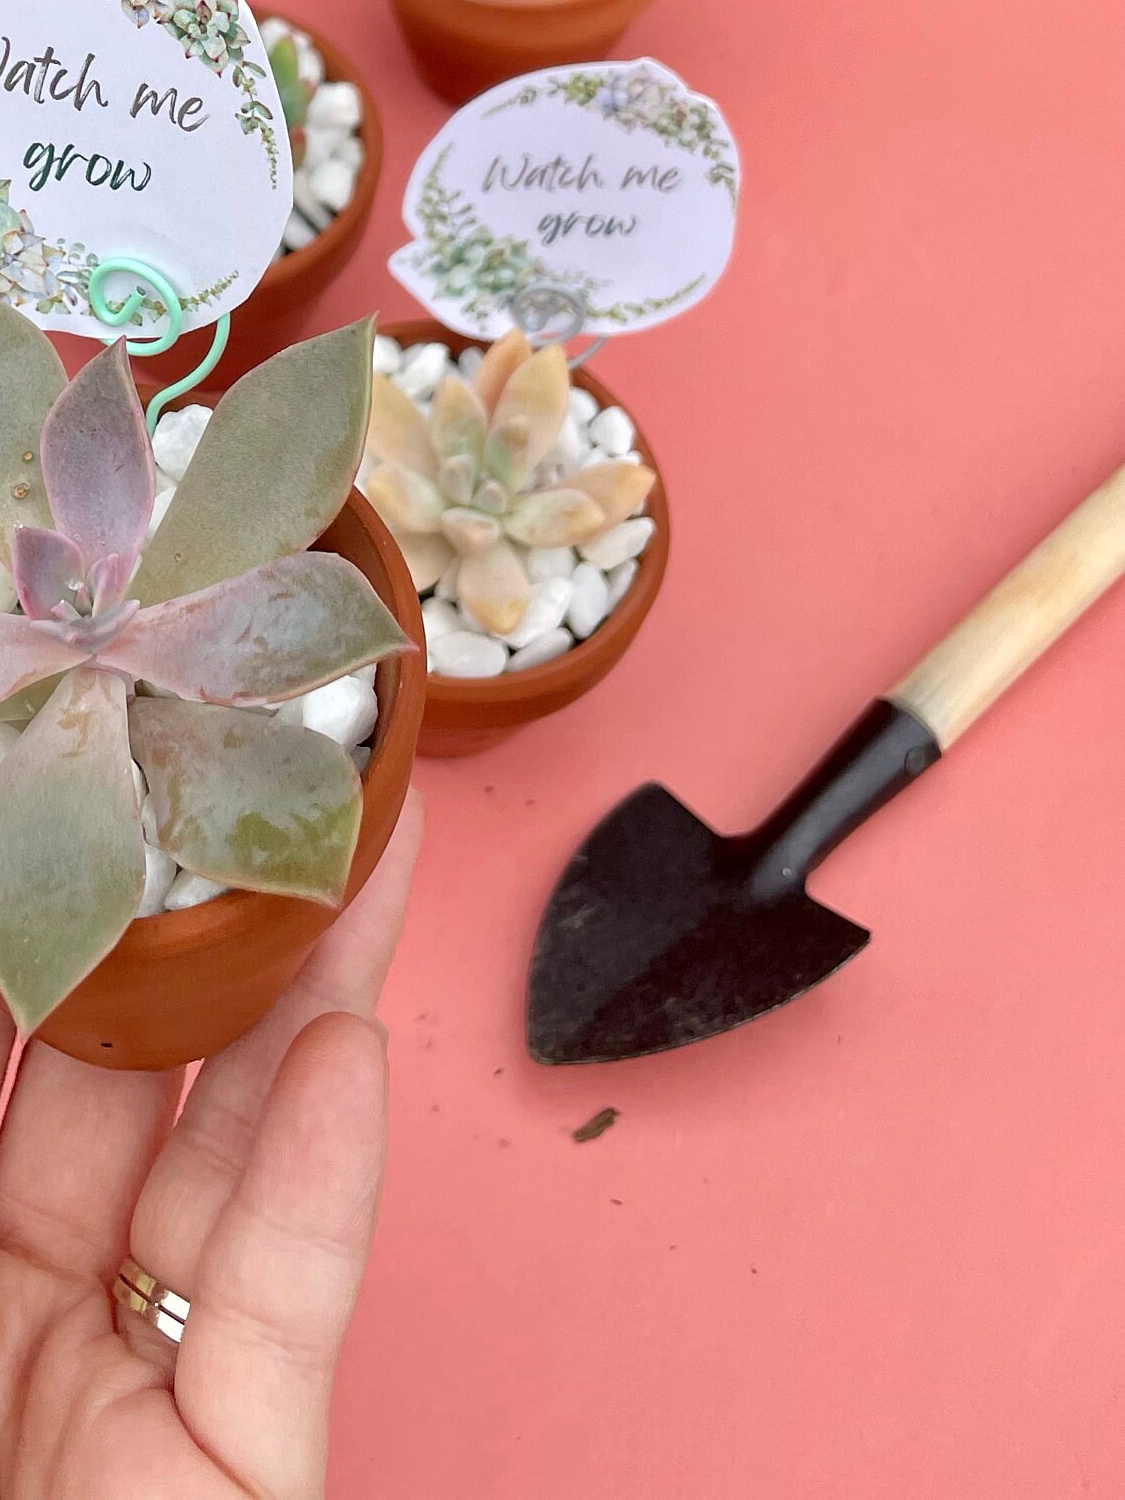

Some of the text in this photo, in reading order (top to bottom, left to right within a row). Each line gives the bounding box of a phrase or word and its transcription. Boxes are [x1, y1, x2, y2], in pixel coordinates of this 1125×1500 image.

[129, 81, 211, 132] me
[22, 140, 152, 192] grow
[481, 154, 684, 194] Watch me
[536, 212, 638, 245] grow
